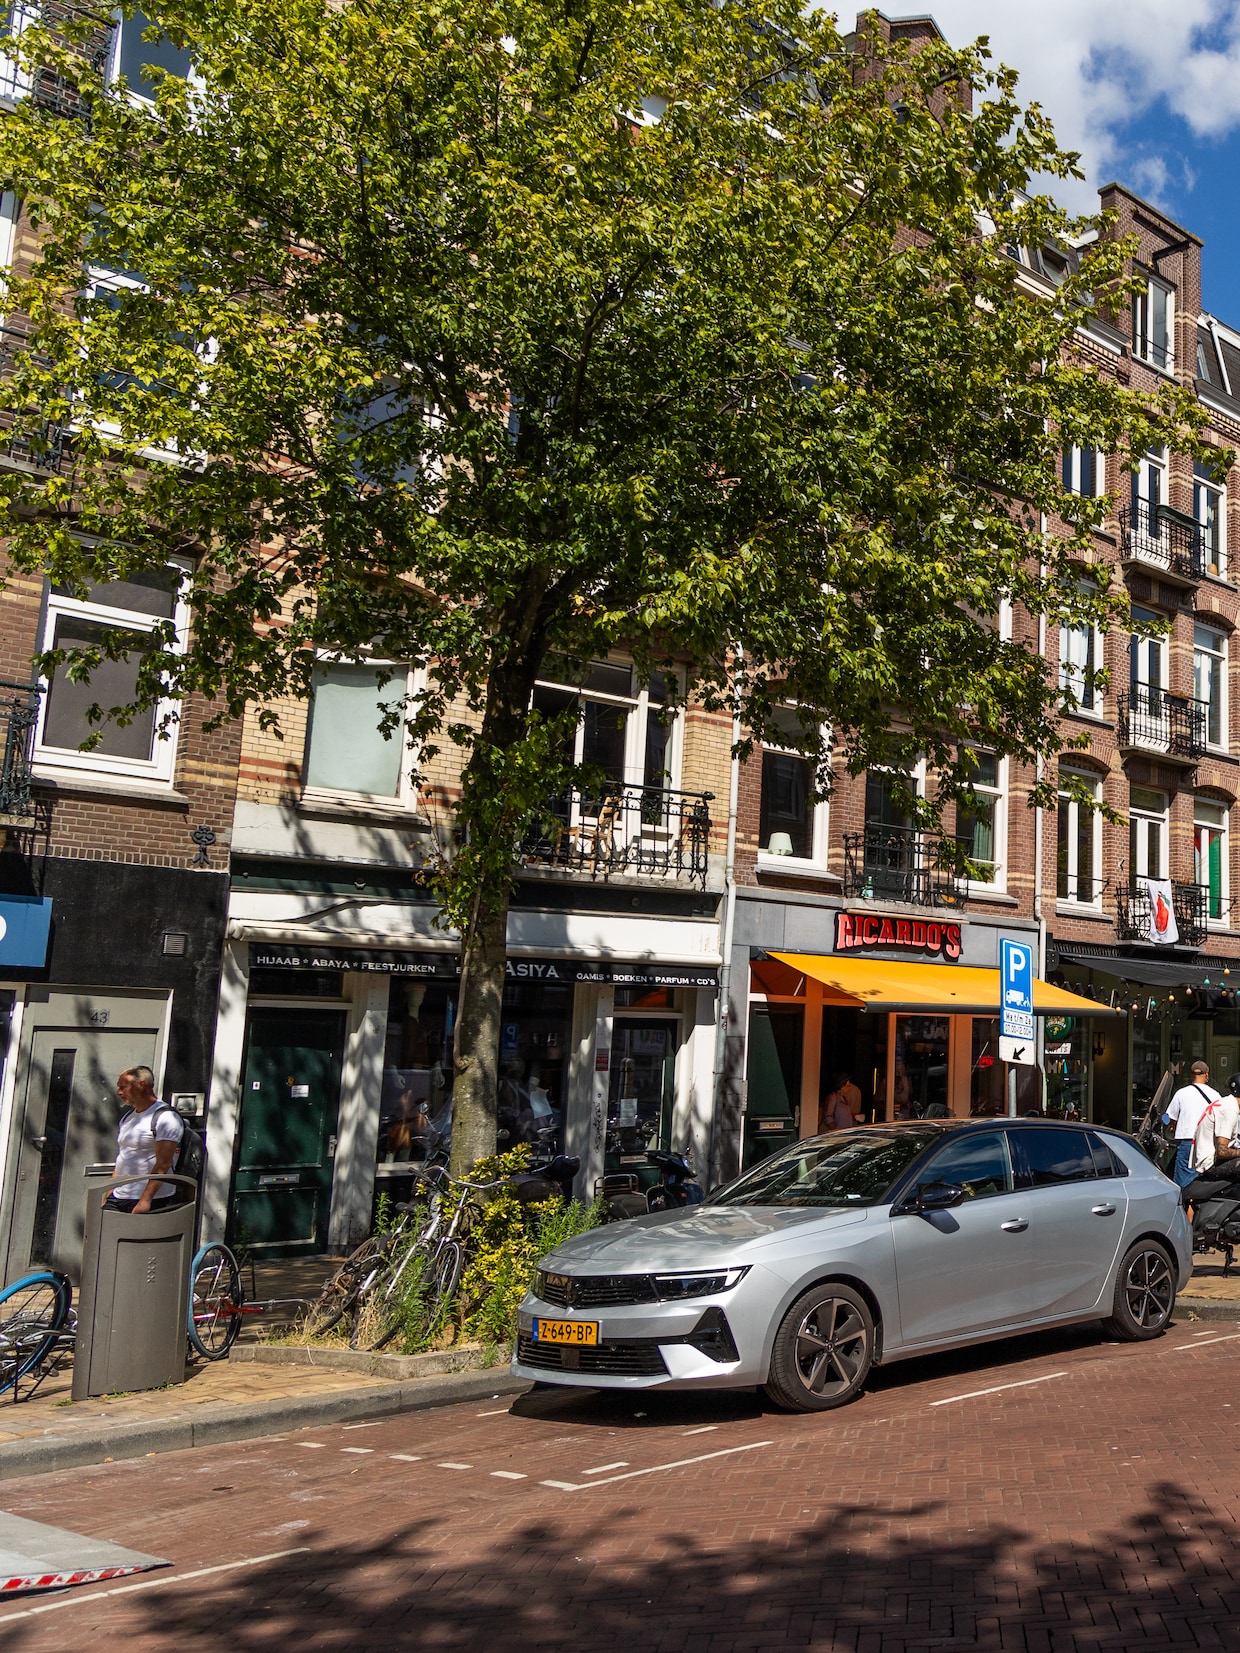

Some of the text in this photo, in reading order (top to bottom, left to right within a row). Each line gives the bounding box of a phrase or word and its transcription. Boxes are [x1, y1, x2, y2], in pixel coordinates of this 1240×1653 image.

[836, 913, 961, 958] RICARDO'S
[256, 956, 436, 973] HIJAAB ABAYA FEESTJURKEN
[1009, 947, 1026, 982] P
[576, 972, 716, 986] QAMIS BOEKEN PARFUM CD'S
[90, 1012, 108, 1024] 43
[1005, 1011, 1031, 1025] Ma t/m Za
[541, 1322, 593, 1342] Z-649-BP
